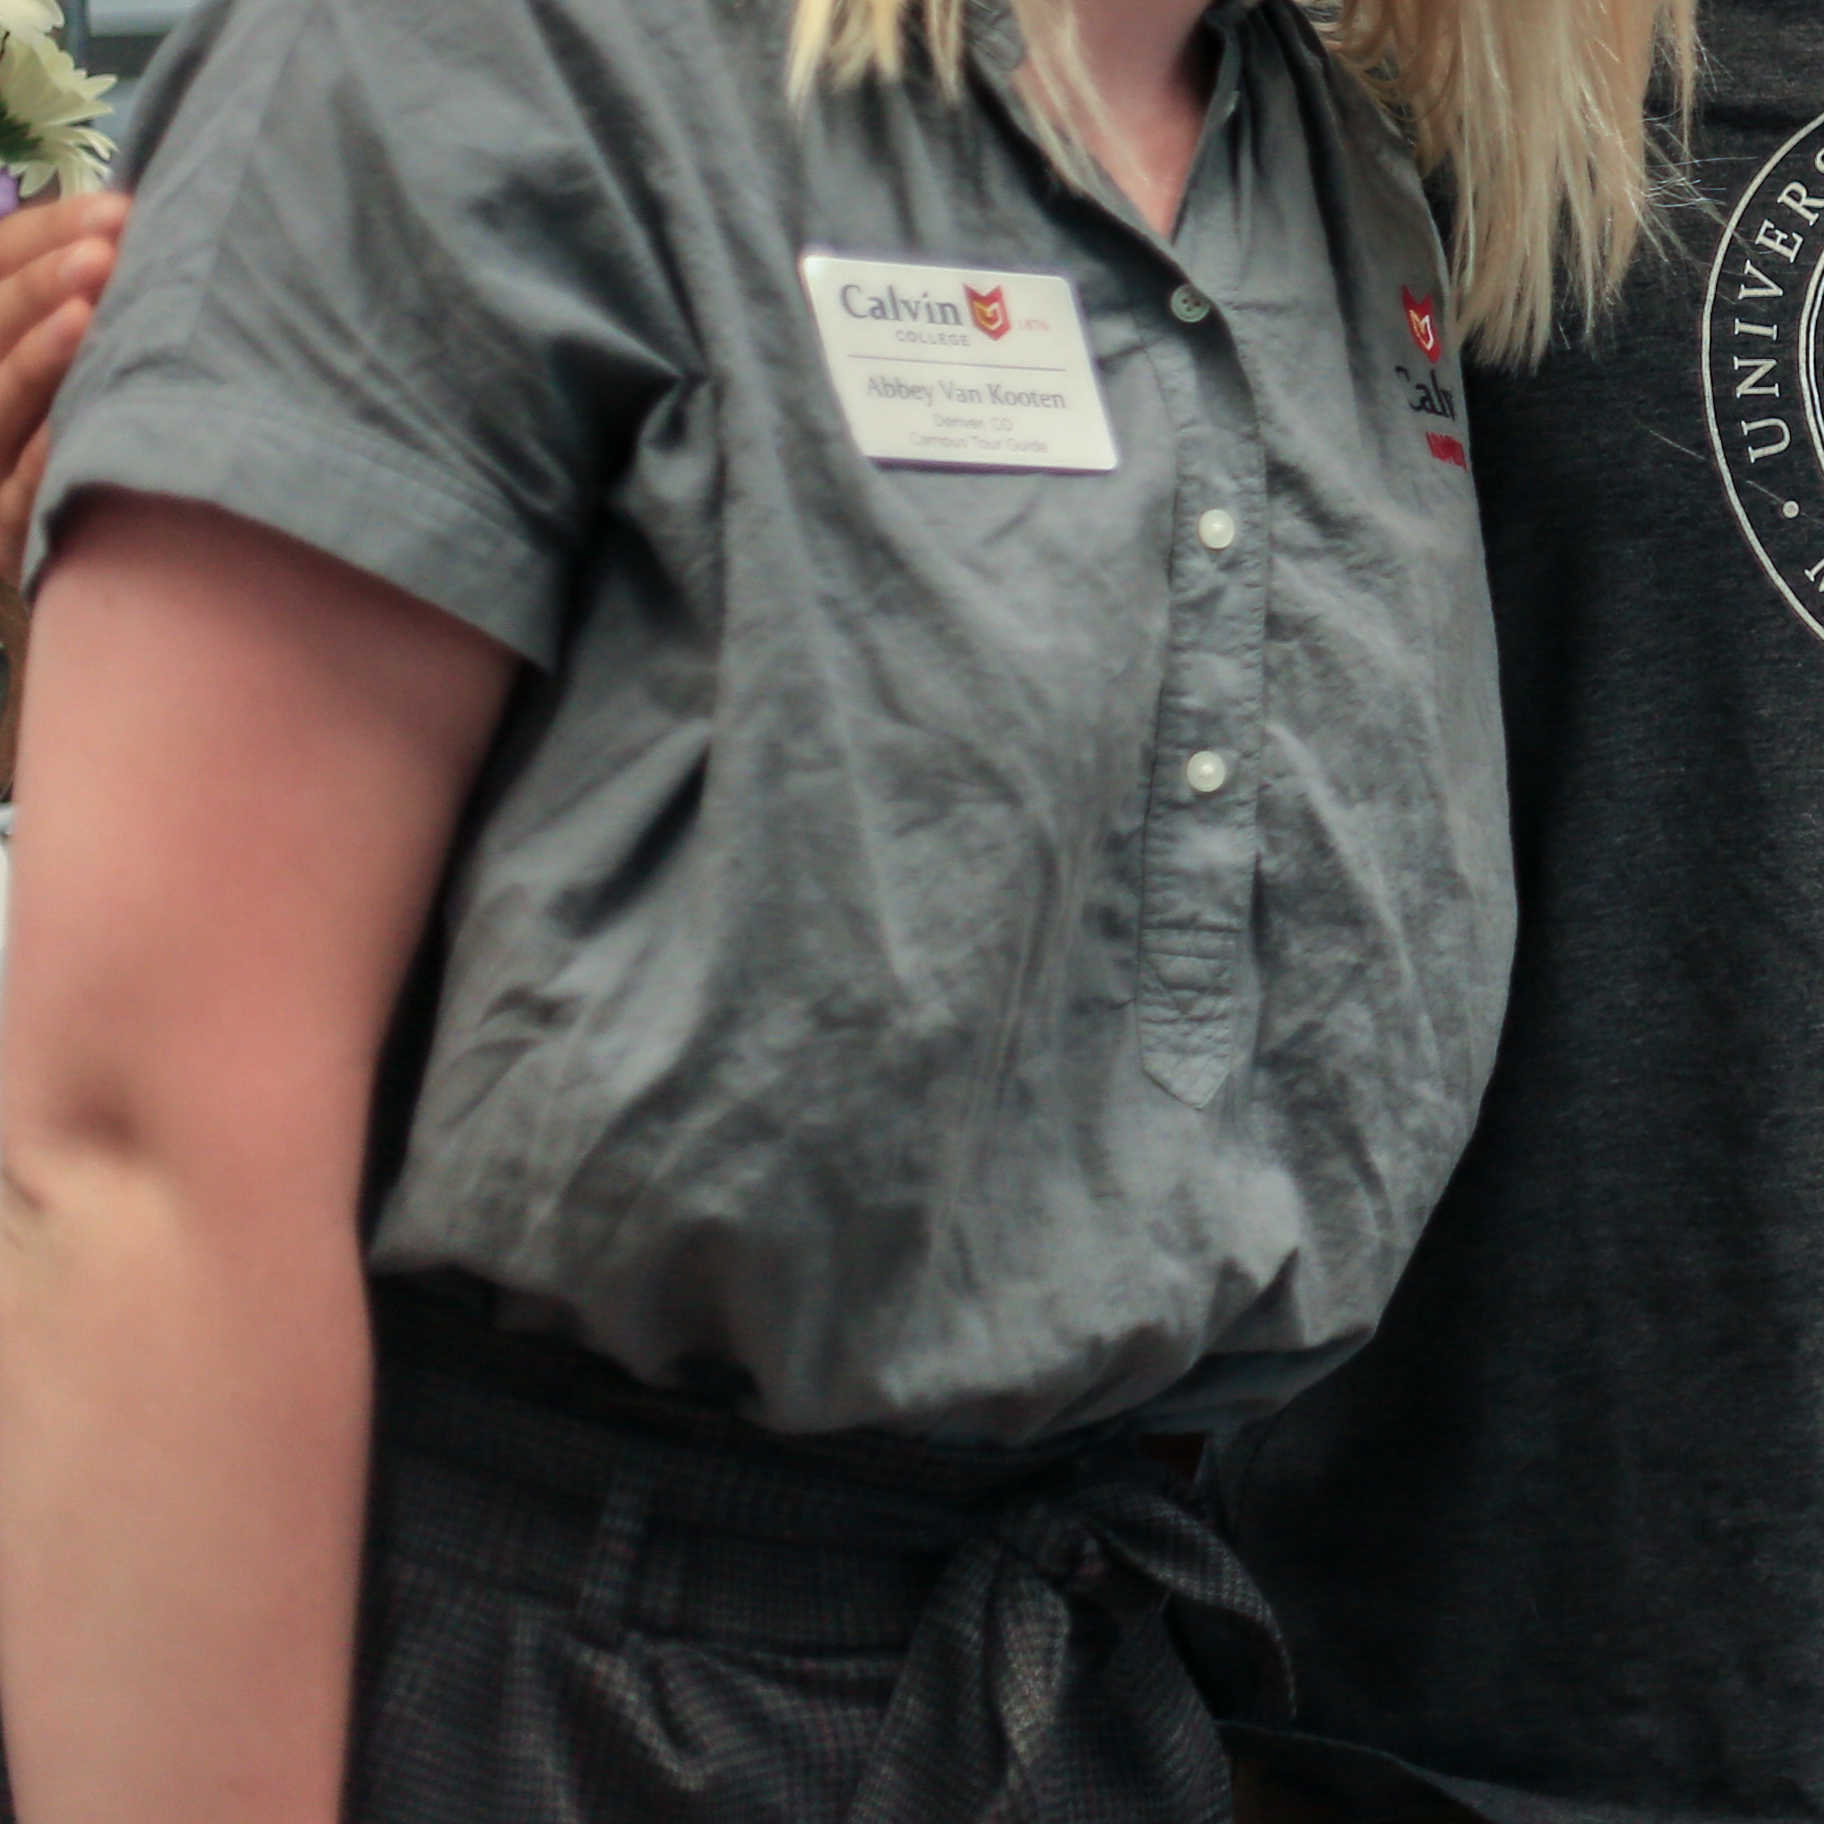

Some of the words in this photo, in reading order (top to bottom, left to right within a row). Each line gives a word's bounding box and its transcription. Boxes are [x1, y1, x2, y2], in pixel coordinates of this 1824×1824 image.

[840, 283, 963, 326] Calvin
[896, 329, 970, 347] COLLEGE
[866, 375, 933, 407] Abbey
[938, 380, 982, 404] Van
